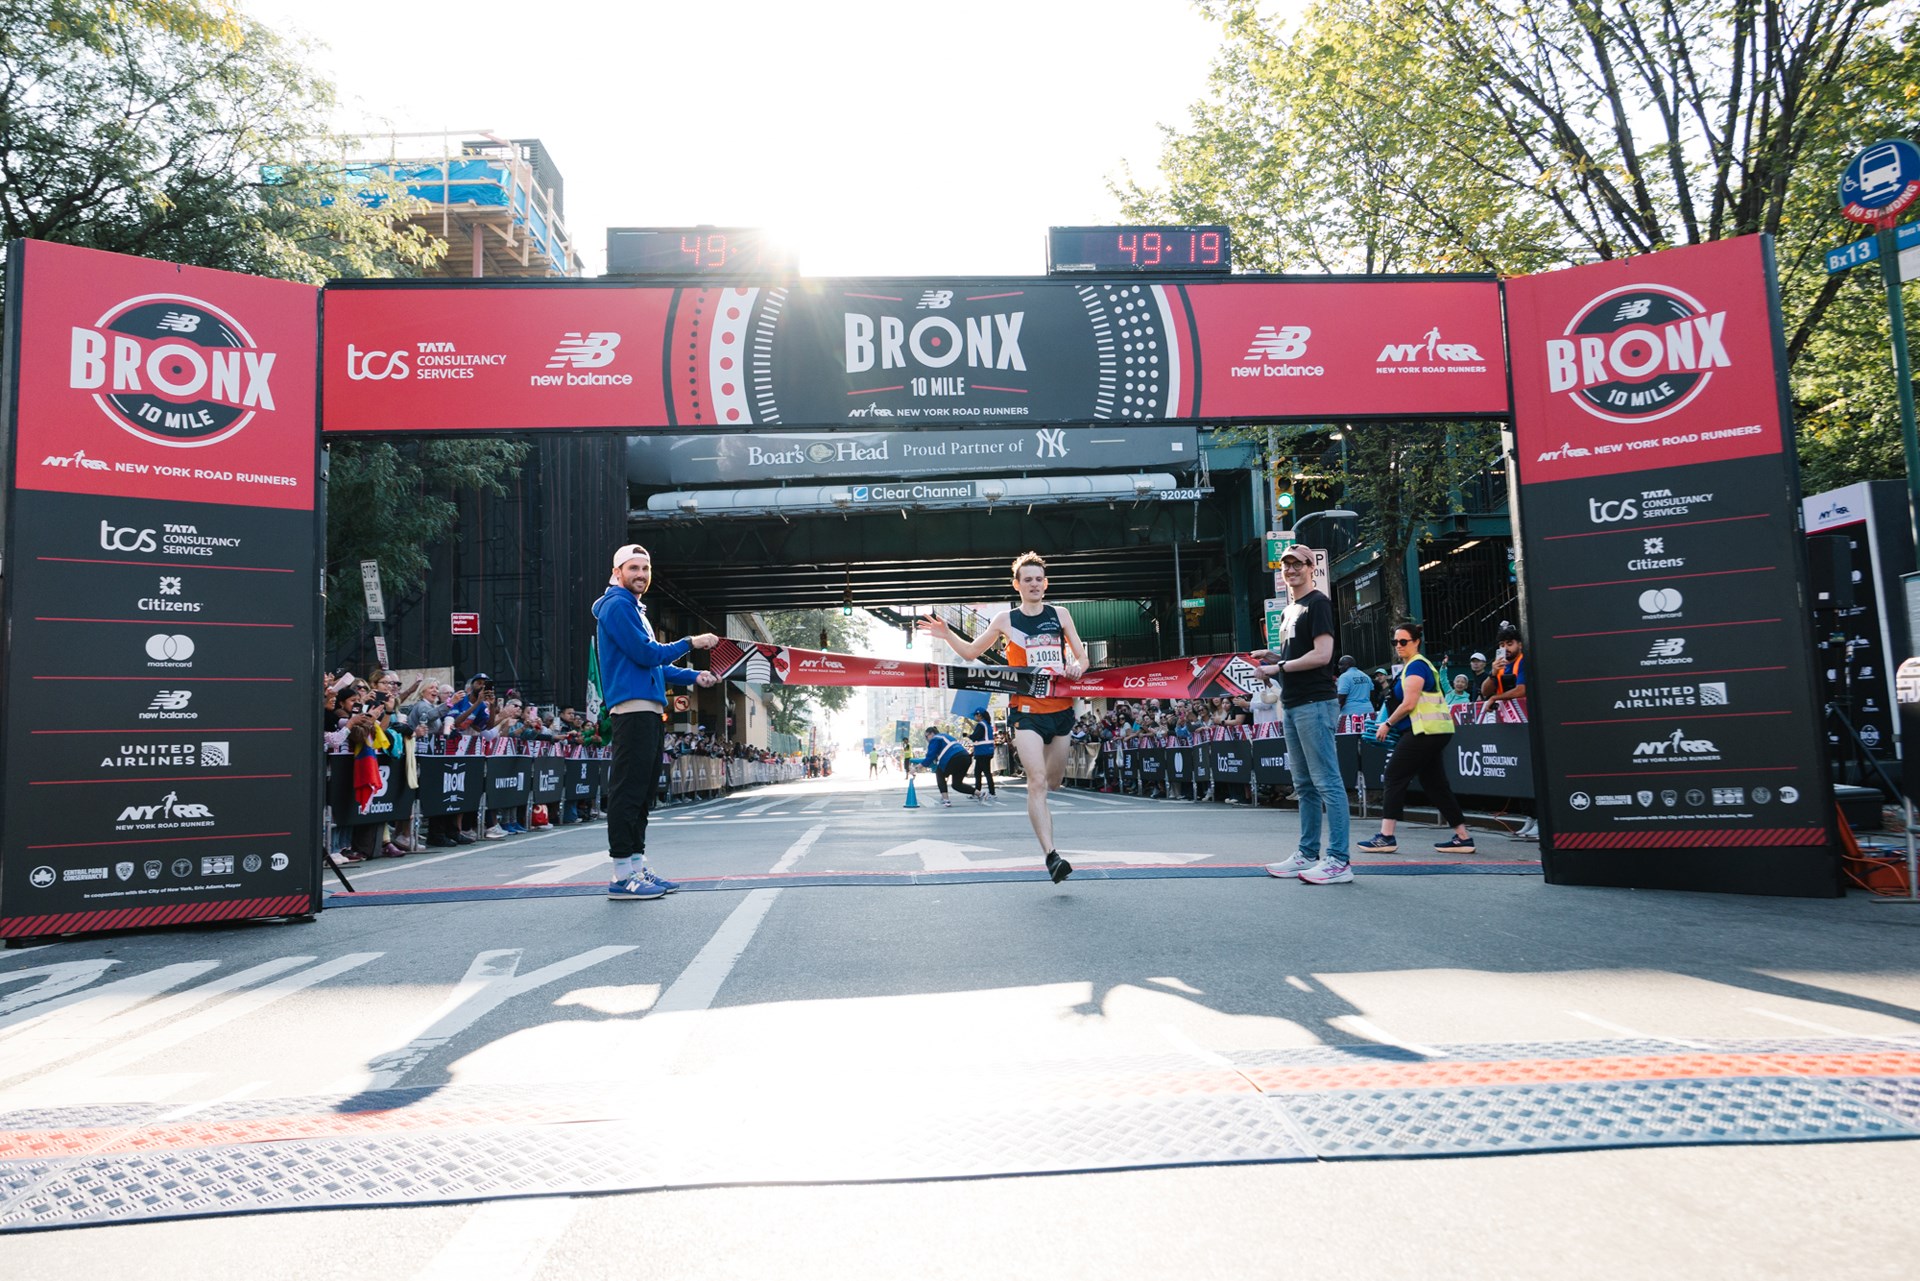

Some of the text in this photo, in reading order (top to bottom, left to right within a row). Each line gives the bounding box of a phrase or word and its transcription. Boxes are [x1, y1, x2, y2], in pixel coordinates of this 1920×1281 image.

[1848, 183, 1919, 220] NO STANDING
[1829, 241, 1871, 270] Bx13
[416, 342, 456, 353] TATA
[844, 311, 1028, 374] BRONX
[1546, 311, 1732, 394] BRONX
[347, 343, 410, 381] tcs
[416, 354, 507, 367] CONSULTANCY
[70, 326, 277, 412] BRONX
[416, 368, 474, 380] SERVICES
[1231, 364, 1325, 378] new balance
[1376, 366, 1487, 374] NEW YORK ROAD RUNNERS
[530, 372, 633, 387] new balance
[910, 376, 966, 396] 10 MILE
[1606, 381, 1676, 407] 10 MILE
[136, 402, 214, 429] 10 MILE
[897, 408, 921, 417] NEW
[922, 408, 950, 416] YORK
[952, 408, 980, 416] ROAD
[983, 406, 1029, 416] RUNNERS
[1036, 428, 1068, 458] NY
[1594, 444, 1623, 455] NEW
[1626, 439, 1660, 450] YORK
[1662, 434, 1699, 446] ROAD
[1700, 424, 1763, 442] RUNNERS
[748, 440, 889, 466] Boar's Head
[903, 438, 1024, 456] Proud Partner of
[115, 462, 150, 473] NEW
[152, 465, 192, 478] YORK
[194, 469, 234, 482] ROAD
[236, 472, 298, 487] RUNNERS
[872, 484, 971, 500] Clear Channel
[1160, 490, 1201, 500] 920204
[1641, 488, 1672, 500] TATA
[1642, 493, 1714, 509] CONSULTANCY
[1588, 497, 1638, 524] tcs
[1642, 506, 1689, 518] SERVICES
[162, 524, 198, 534] TATA
[100, 520, 157, 552] tcs
[162, 534, 241, 547] CONSULTANCY
[162, 545, 213, 556] SERVICES
[1627, 557, 1684, 571] Citizens
[362, 565, 376, 578] STOP
[137, 598, 202, 612] Citizens
[1642, 612, 1682, 620] mastercard
[1036, 650, 1060, 662] 10181
[1640, 656, 1693, 666] new balance
[1123, 676, 1146, 688] tcs
[1628, 686, 1694, 698] UNITED
[1614, 696, 1696, 709] AIRLINES
[138, 712, 198, 720] new balance
[120, 744, 196, 755] UNITED
[1482, 744, 1498, 754] TATA
[100, 756, 196, 768] AIRLINES
[1260, 757, 1284, 767] UNITED
[1458, 745, 1481, 776] tcs
[1482, 756, 1518, 766] CONSULTANCY
[1483, 767, 1506, 778] SERVICES
[495, 777, 517, 789] UNITED
[370, 802, 394, 813] balance
[180, 820, 215, 828] RUNNERS
